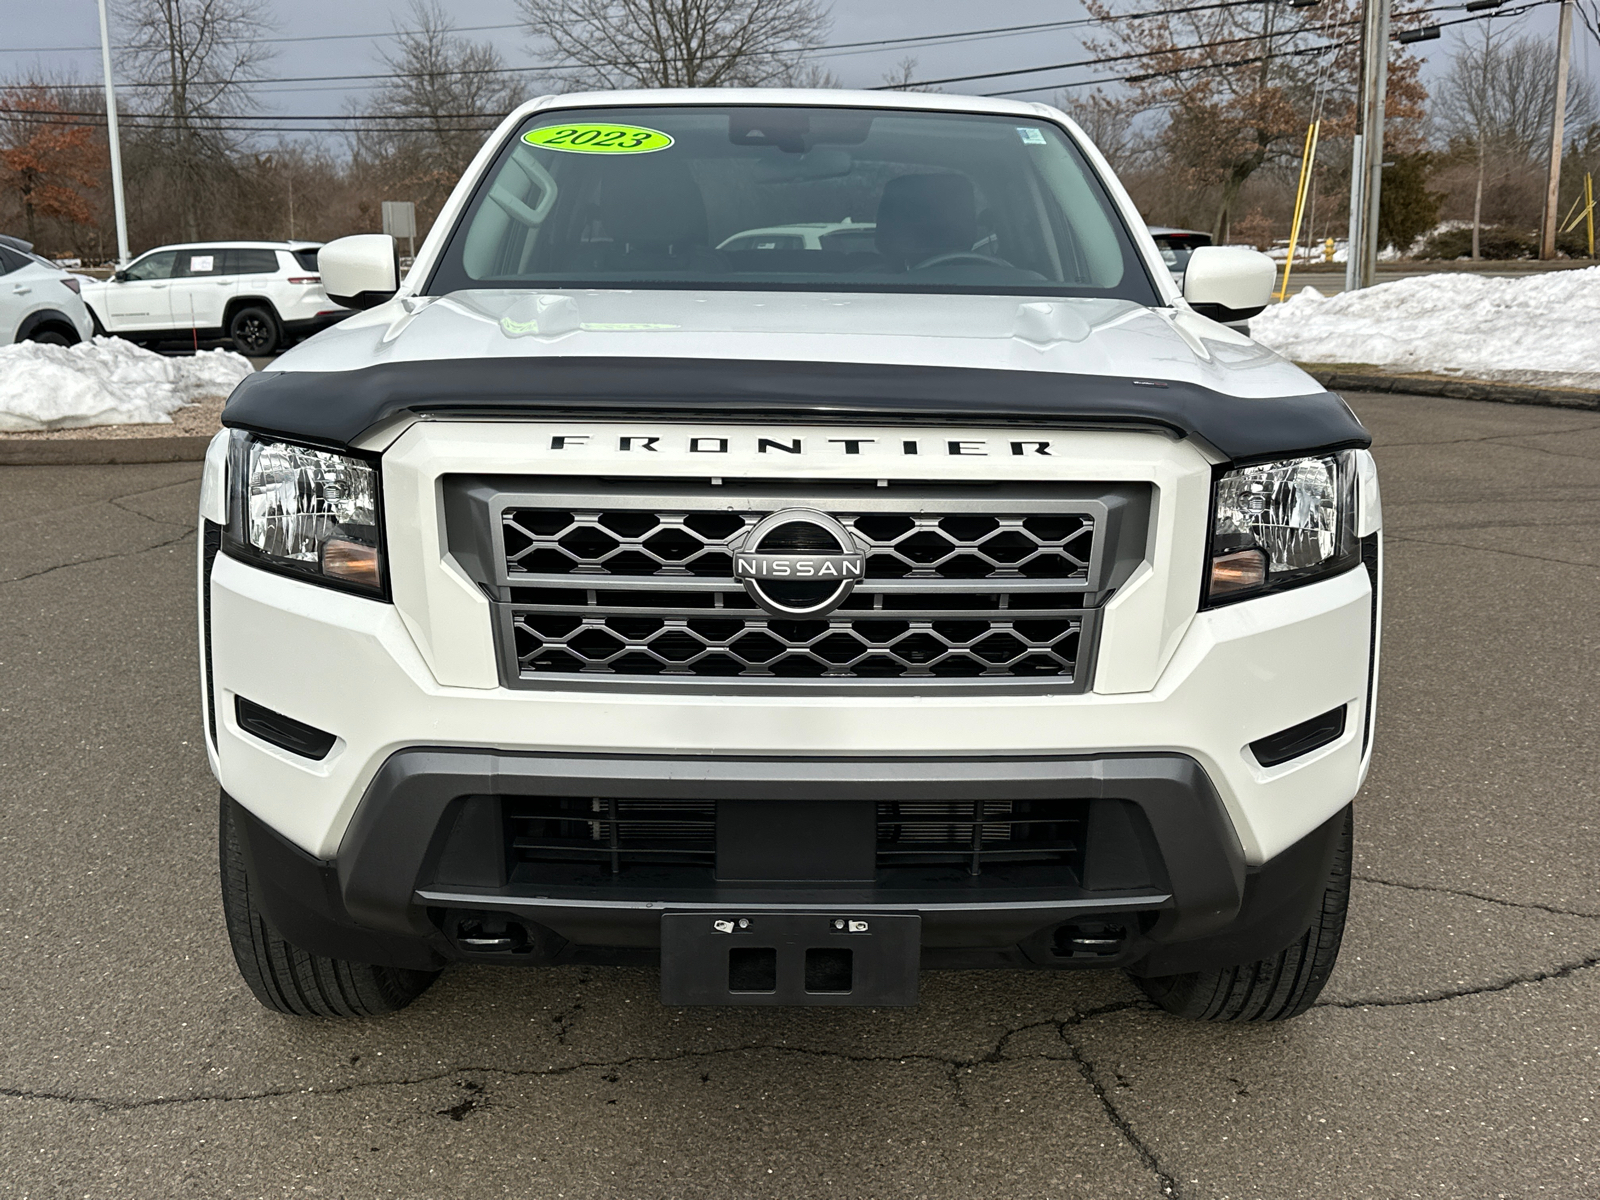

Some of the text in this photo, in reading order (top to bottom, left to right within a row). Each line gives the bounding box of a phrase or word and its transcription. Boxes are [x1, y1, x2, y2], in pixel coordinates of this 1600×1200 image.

[542, 129, 652, 148] 2023
[550, 435, 1056, 456] FRONTIER
[738, 558, 860, 576] NISSAN
